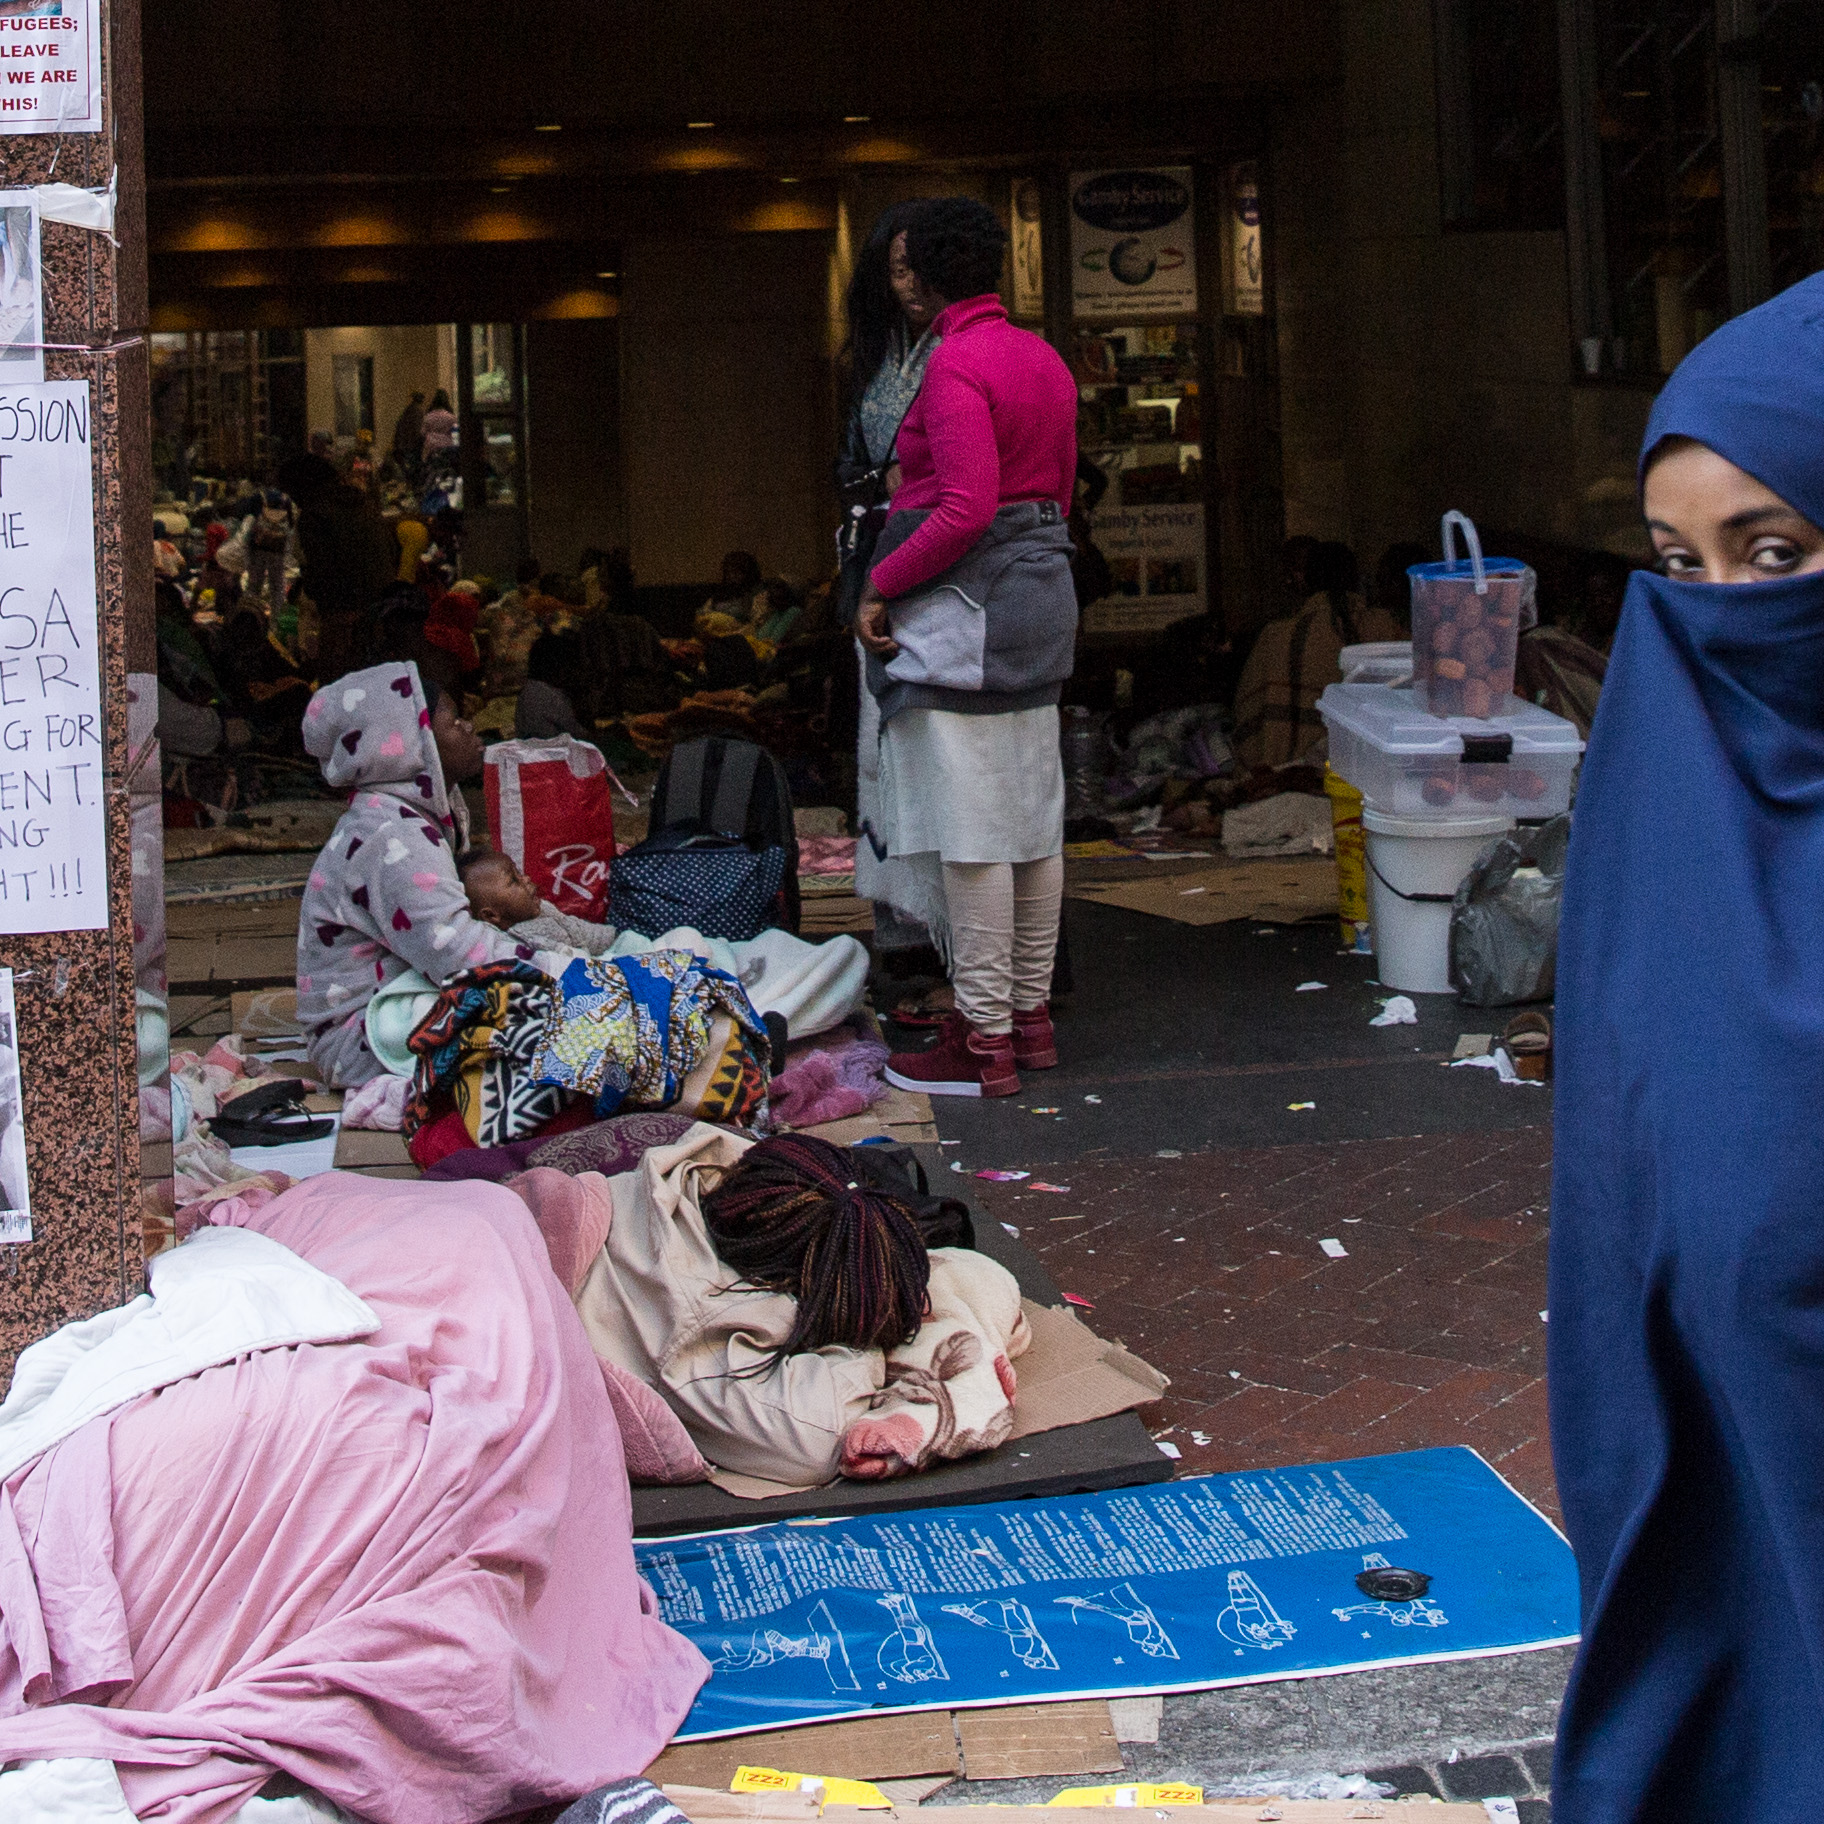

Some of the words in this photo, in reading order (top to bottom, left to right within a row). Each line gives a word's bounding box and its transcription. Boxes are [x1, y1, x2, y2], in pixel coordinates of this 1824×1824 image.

[0, 43, 60, 58] LEAVE
[7, 71, 35, 84] WE
[40, 69, 78, 84] ARE
[43, 712, 102, 753] FOR
[745, 1772, 786, 1787] ZZ2
[1158, 1789, 1197, 1802] ZZ2
